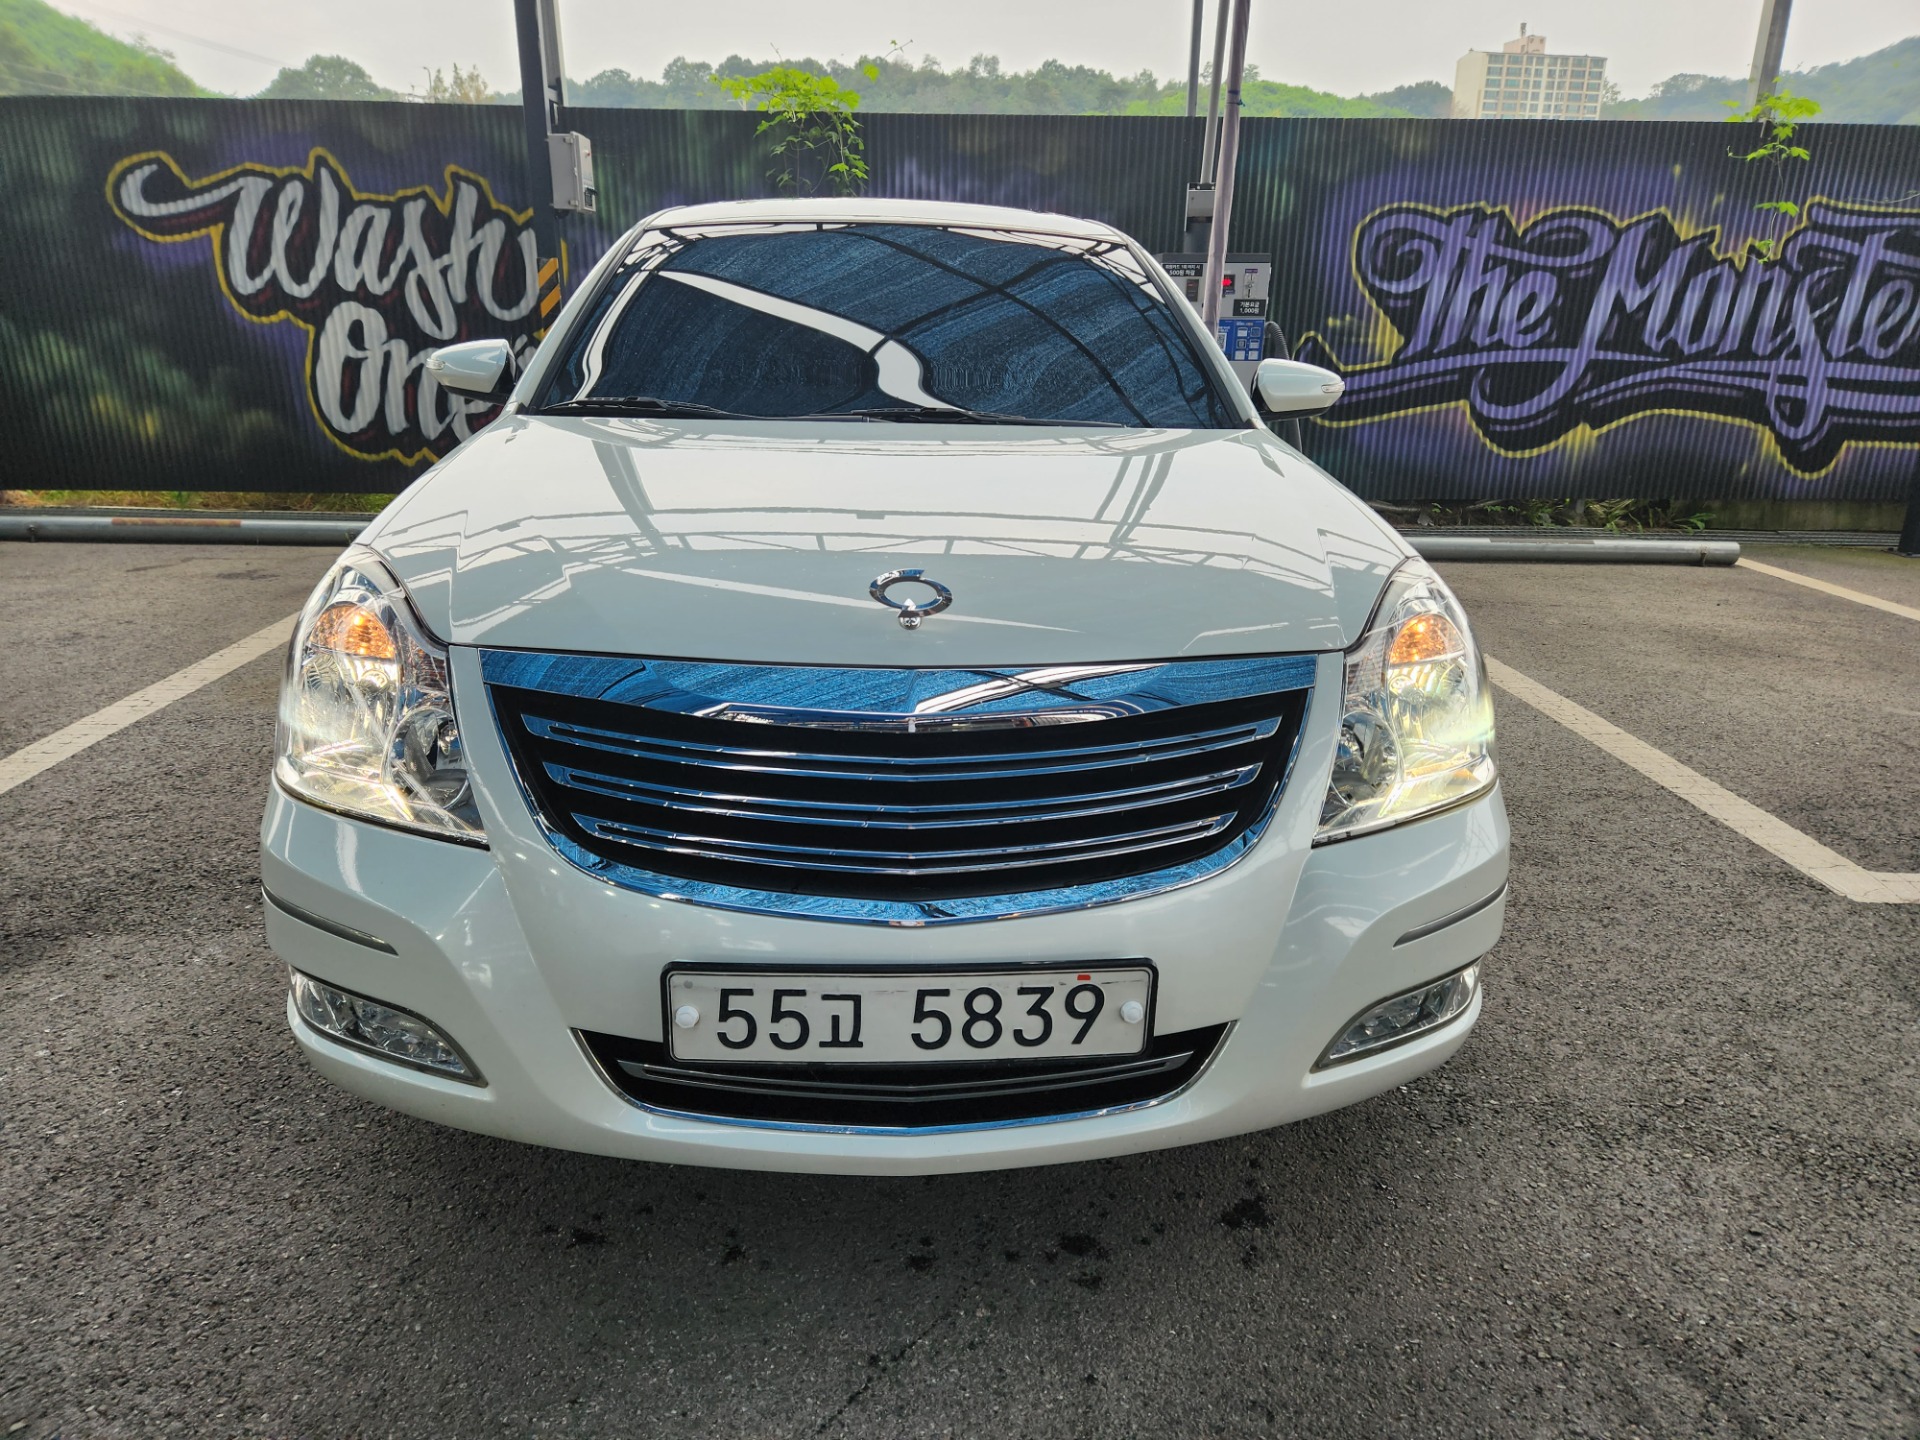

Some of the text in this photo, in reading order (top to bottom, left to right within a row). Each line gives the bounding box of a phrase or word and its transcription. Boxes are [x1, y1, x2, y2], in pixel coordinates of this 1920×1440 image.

[119, 165, 541, 340] Wash
[1360, 211, 1614, 358] The
[717, 984, 1106, 1050] 55고 5839
